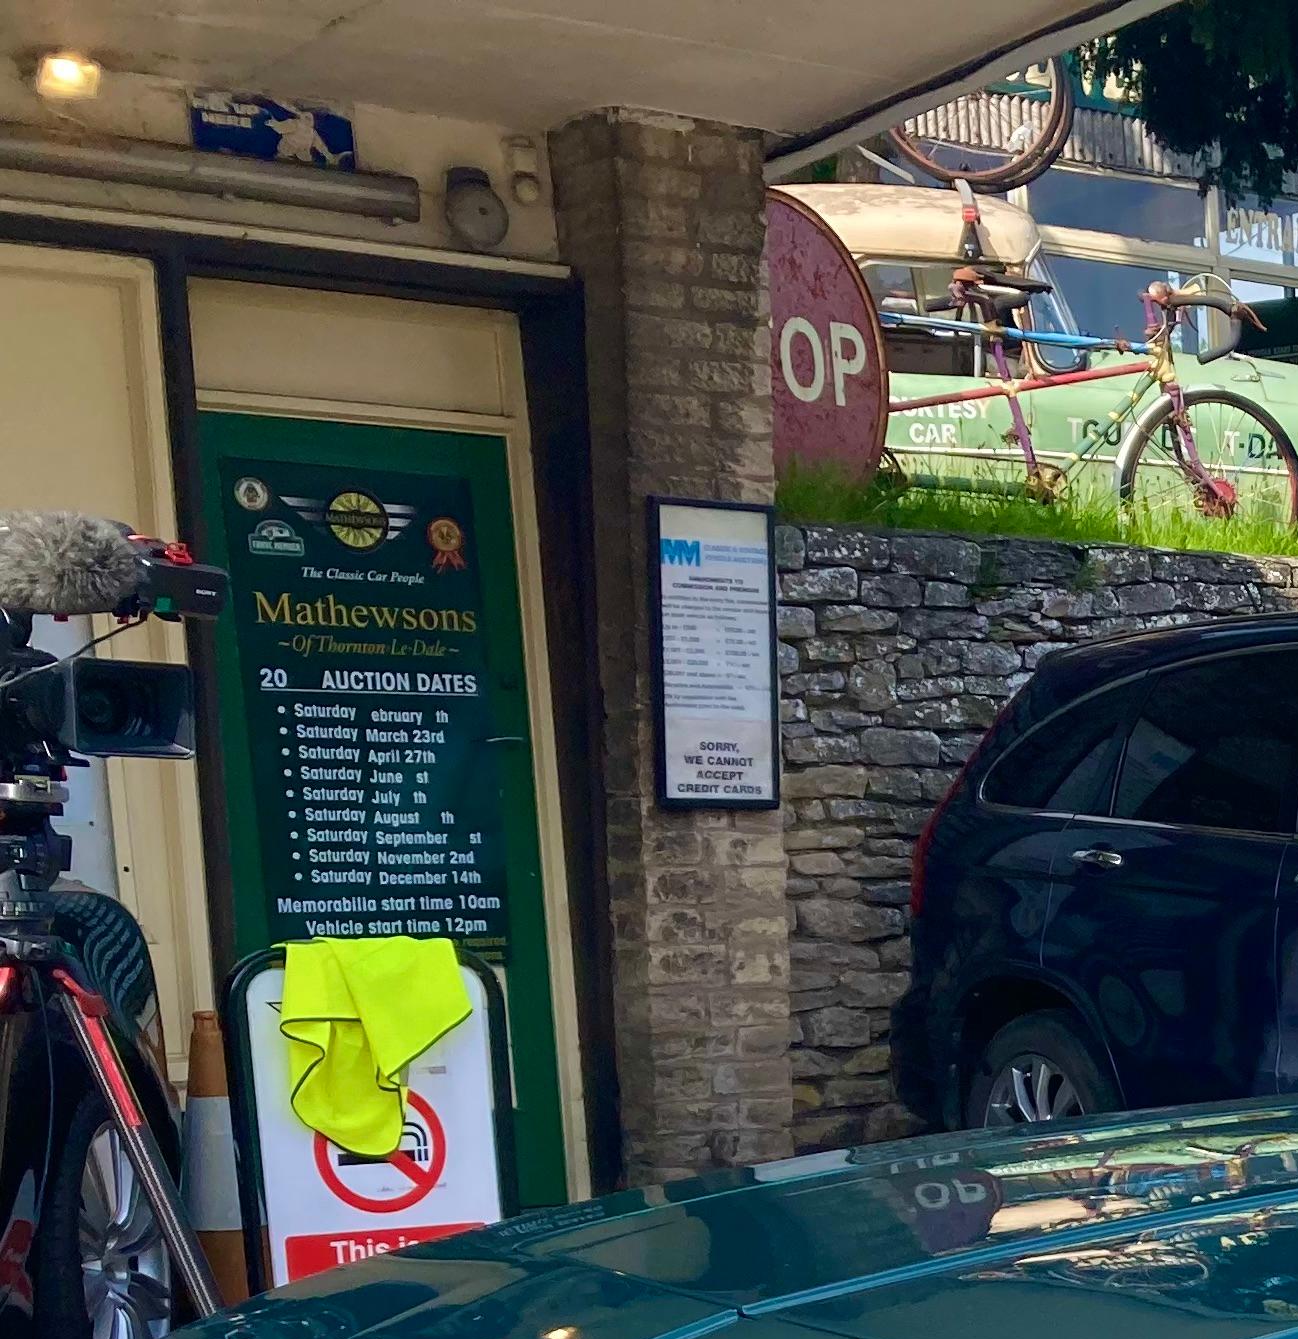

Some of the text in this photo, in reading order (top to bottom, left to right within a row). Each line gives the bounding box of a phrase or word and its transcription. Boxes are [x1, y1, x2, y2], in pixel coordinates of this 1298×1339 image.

[769, 315, 866, 407] OP
[908, 422, 957, 444] CAR
[301, 566, 425, 585] The Classic Car People
[252, 591, 477, 632] Mathewsons
[322, 670, 411, 692] AUCTION
[417, 673, 477, 693] DATES
[294, 703, 356, 720] Saturday
[296, 725, 445, 744] Saturday March 23rd
[298, 745, 436, 765] Saturday April 27th
[700, 741, 740, 753] SORRY,
[684, 755, 754, 767] WE CANNOT
[301, 766, 362, 783] Saturday
[370, 770, 403, 784] June
[696, 770, 744, 781] ACCEPT
[303, 787, 364, 804] Saturday
[372, 791, 400, 805] July
[677, 783, 762, 795] CREDIT CARDS
[304, 808, 366, 824] Saturday
[374, 811, 420, 827] August
[307, 828, 368, 844] Saturday
[376, 831, 448, 847] September
[309, 849, 475, 865] Saturday November 2nd
[311, 869, 482, 885] Saturday December 14th
[277, 895, 501, 913] Memorabilia start time 10am
[305, 918, 487, 935] Vehicle start time 12pm
